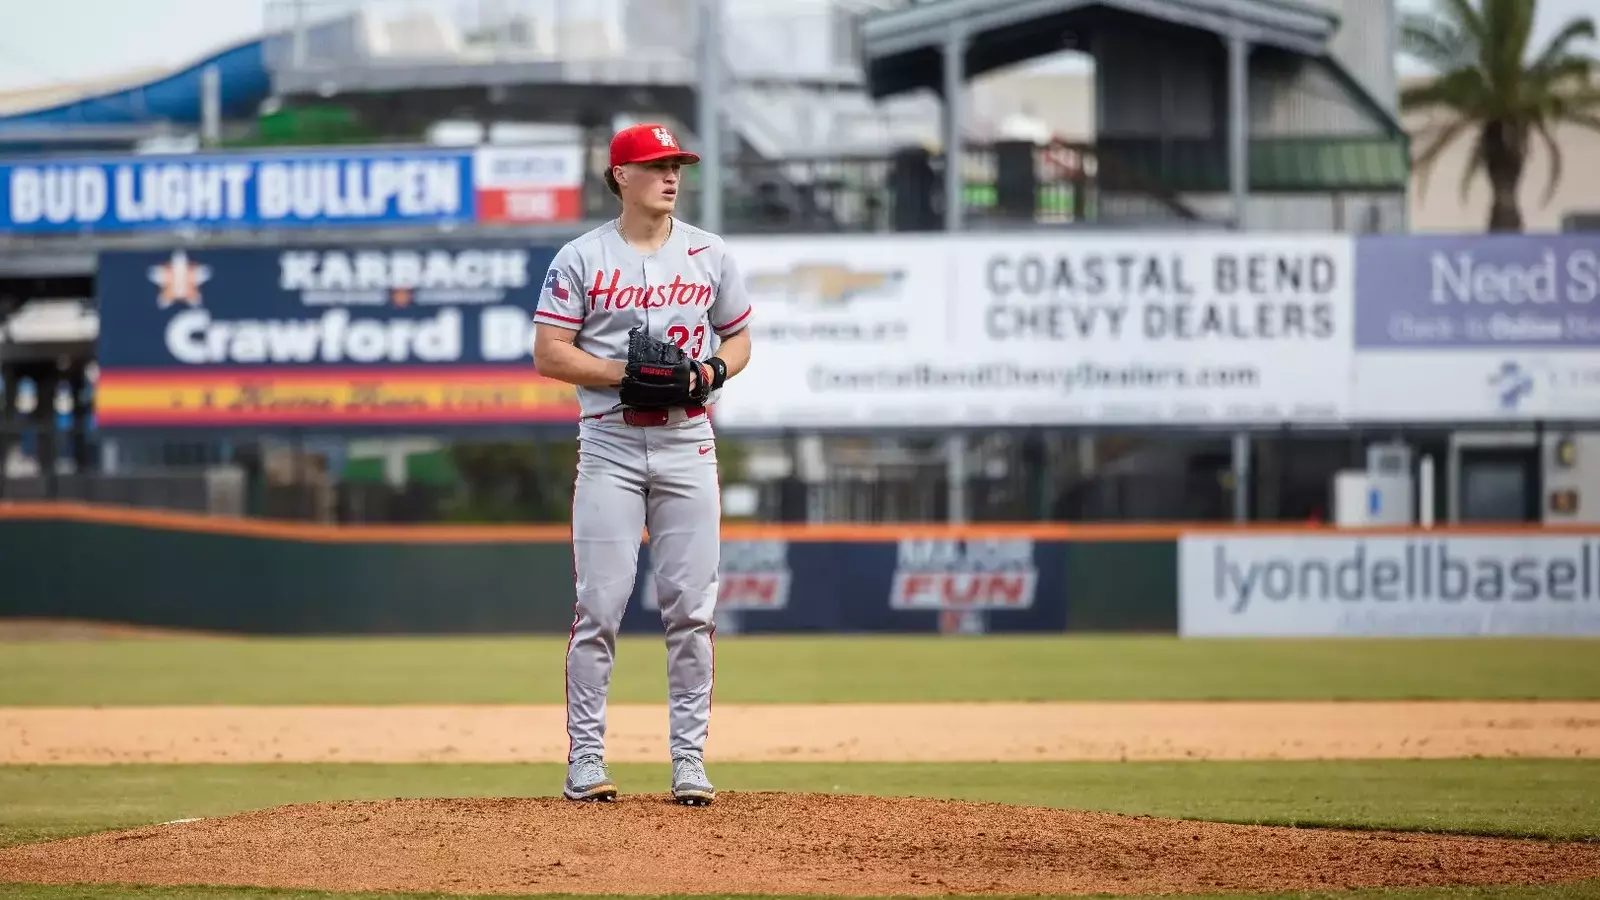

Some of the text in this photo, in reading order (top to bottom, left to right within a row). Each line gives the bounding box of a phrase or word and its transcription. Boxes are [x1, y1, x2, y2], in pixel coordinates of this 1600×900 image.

[11, 165, 108, 224] BUD
[115, 162, 248, 221] LIGHT
[258, 157, 460, 219] BULLPEN
[280, 250, 529, 290] KARBACH
[587, 268, 711, 311] Houston
[985, 253, 1336, 297] COASTAL BEND
[1430, 248, 1600, 304] Need S
[166, 308, 462, 363] Crawford
[666, 325, 705, 359] 23
[984, 302, 1336, 341] CHEVY DEALERS
[902, 575, 1026, 607] FUN
